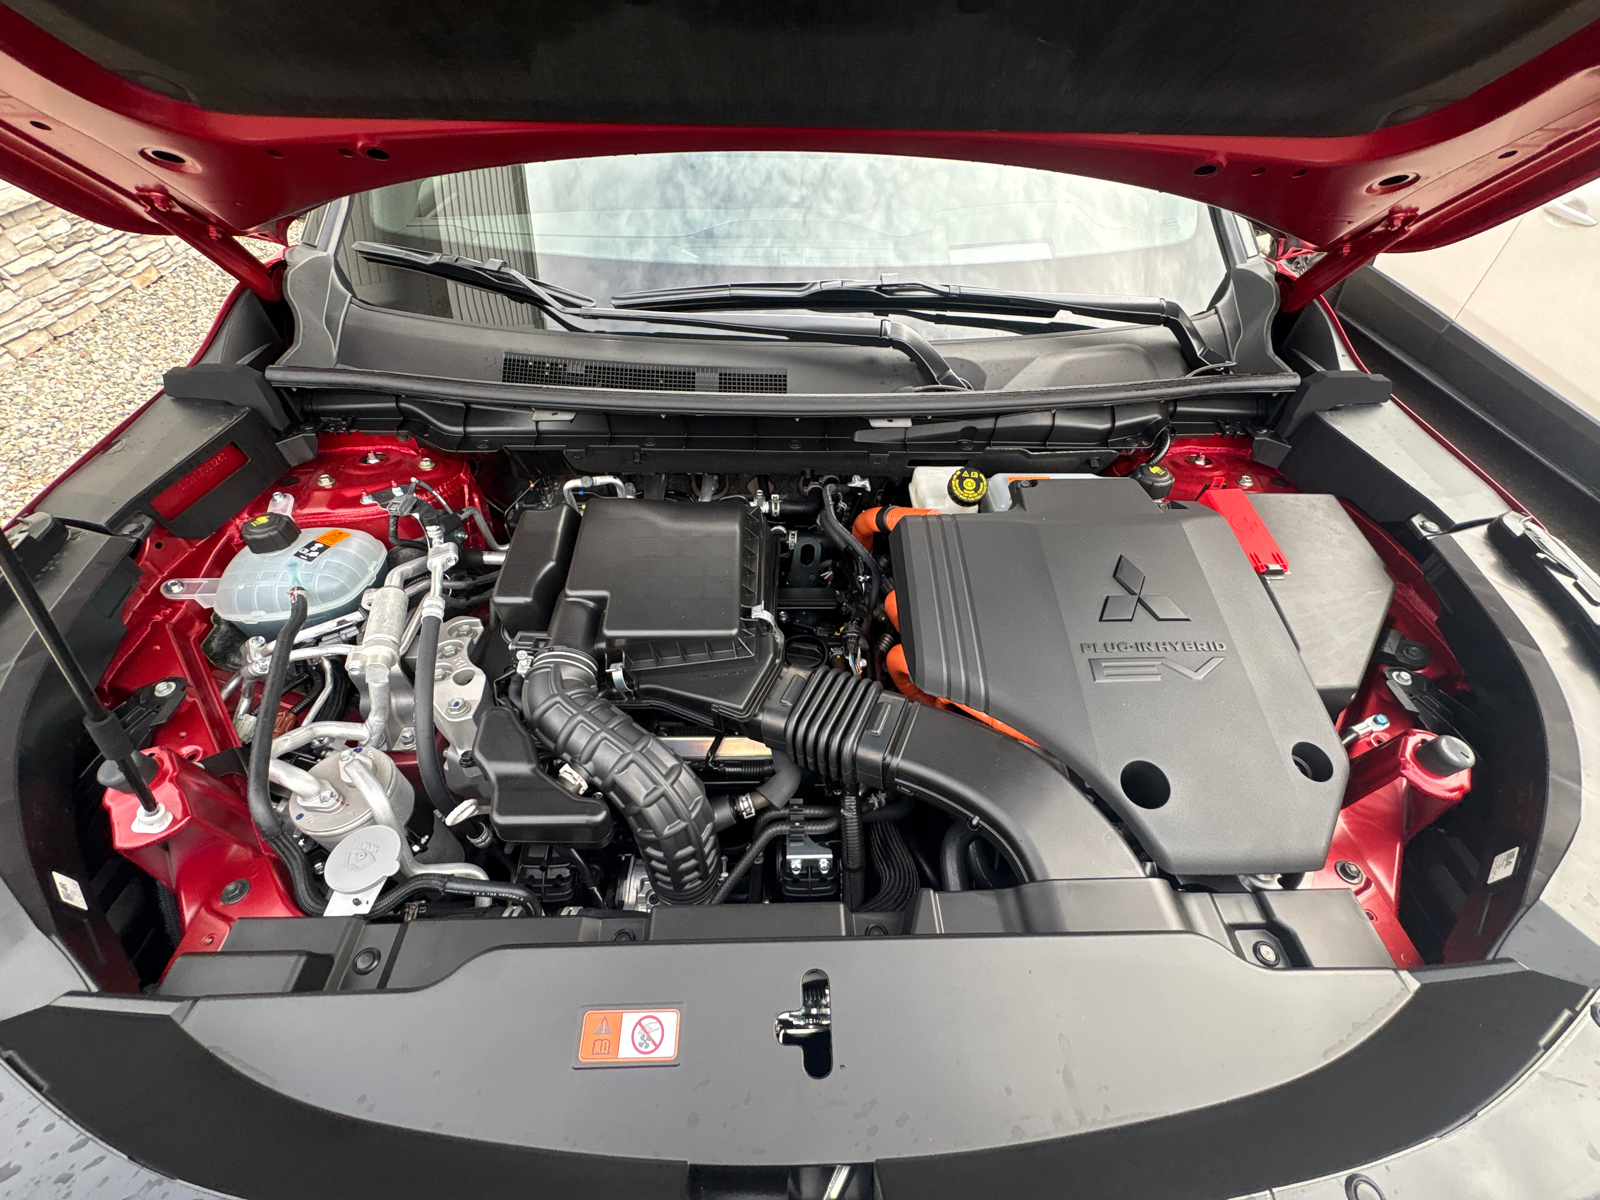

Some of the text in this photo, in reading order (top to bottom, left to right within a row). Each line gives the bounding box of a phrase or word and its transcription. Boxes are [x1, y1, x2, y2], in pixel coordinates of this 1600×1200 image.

[1080, 641, 1228, 653] PLUG-IN HYBRID
[1088, 656, 1227, 683] EV
